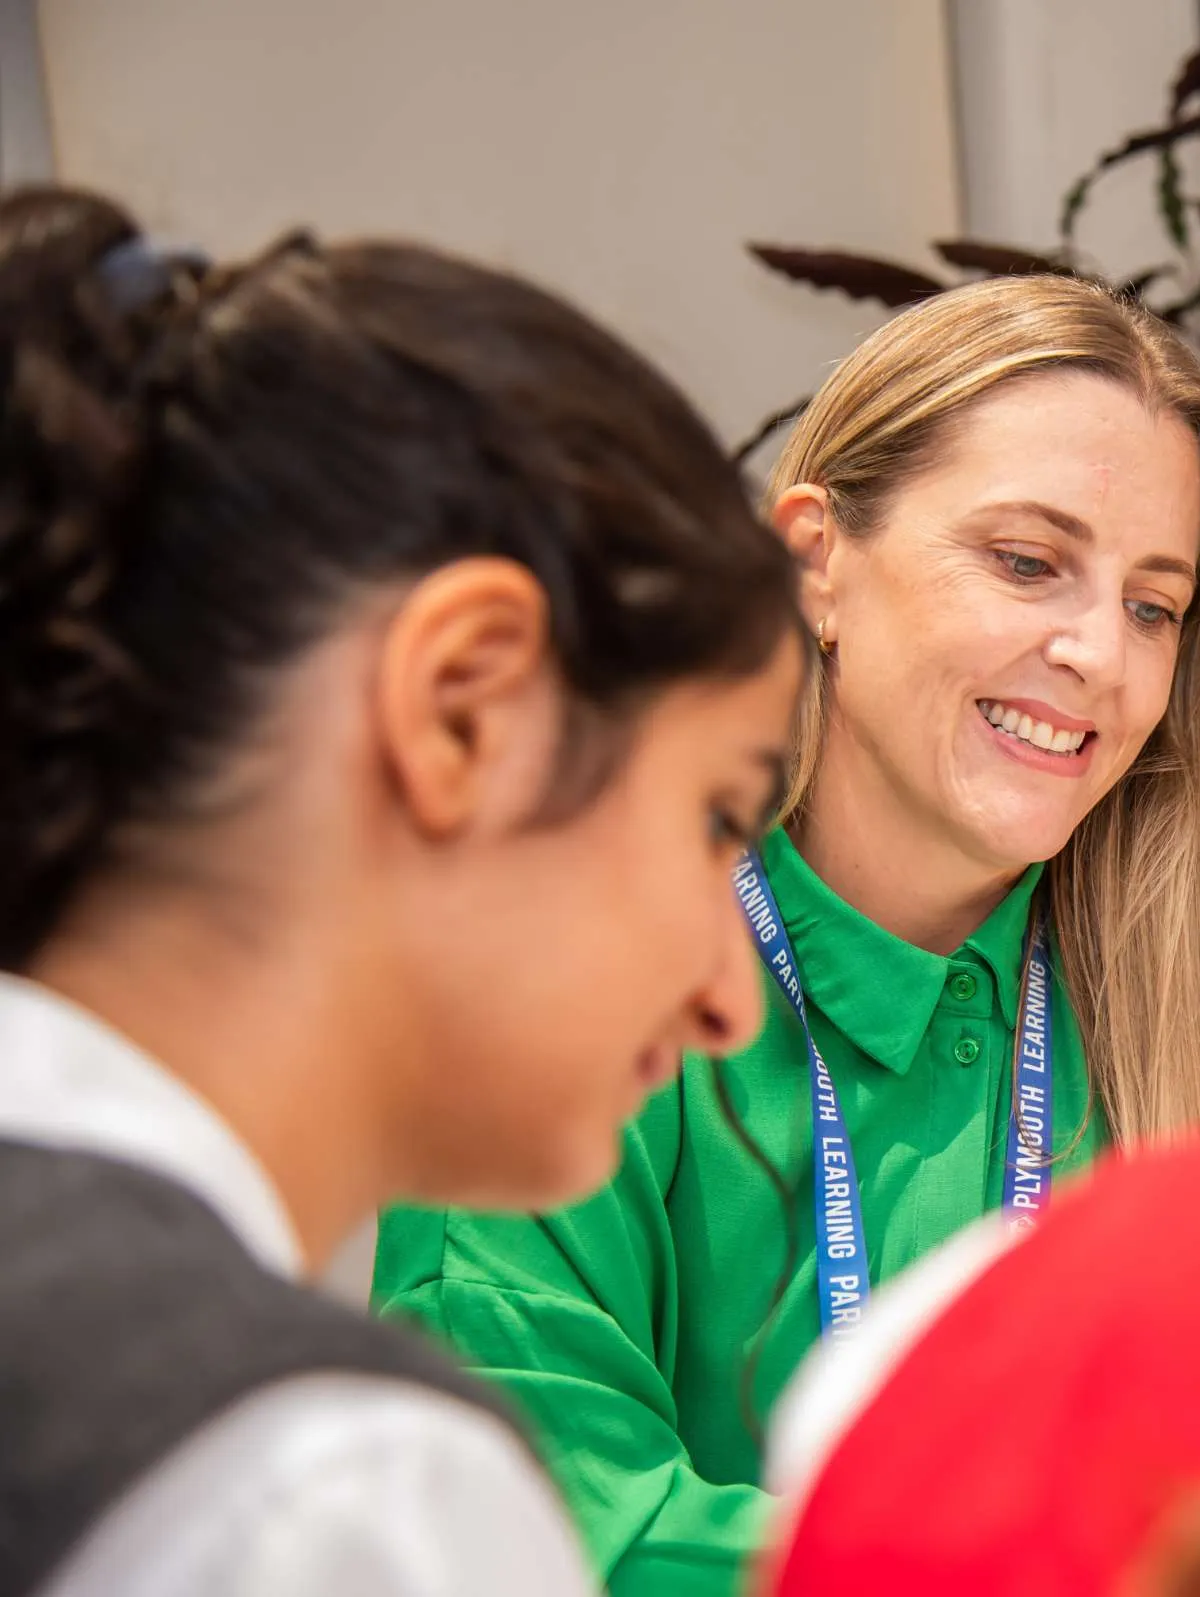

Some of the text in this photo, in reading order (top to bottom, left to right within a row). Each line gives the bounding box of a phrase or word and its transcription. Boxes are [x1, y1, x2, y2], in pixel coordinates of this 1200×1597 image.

[732, 848, 777, 943] ARNING
[1022, 960, 1047, 1073] LEARNING
[811, 1037, 839, 1121] OUTH
[822, 1136, 856, 1259] LEARNING
[1013, 1084, 1044, 1210] PLYMOUTH
